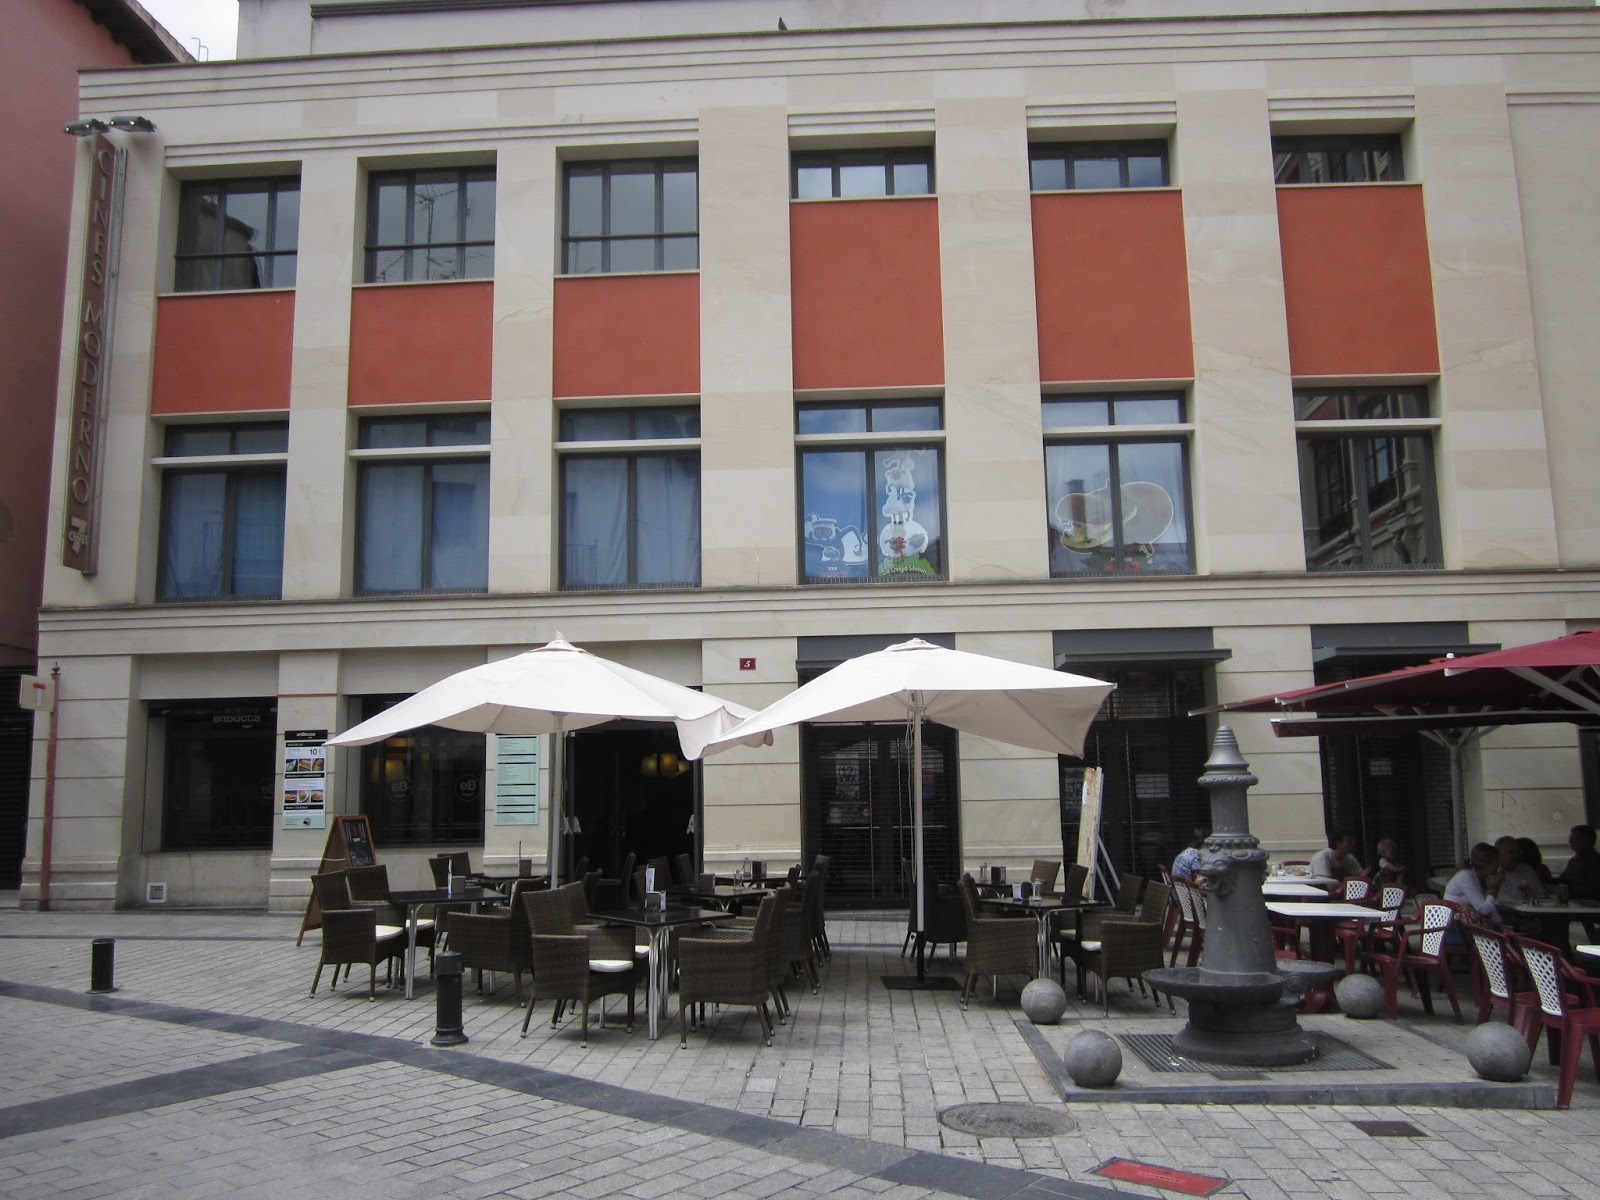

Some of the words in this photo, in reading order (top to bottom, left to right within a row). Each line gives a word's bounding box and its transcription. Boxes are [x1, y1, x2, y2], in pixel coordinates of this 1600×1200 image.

[92, 149, 111, 285] CINES
[73, 300, 102, 504] MODERNO
[890, 565, 908, 574] Oveja
[909, 564, 927, 574] Shaun
[744, 660, 751, 668] 5
[391, 781, 408, 792] eB
[460, 780, 476, 791] eB
